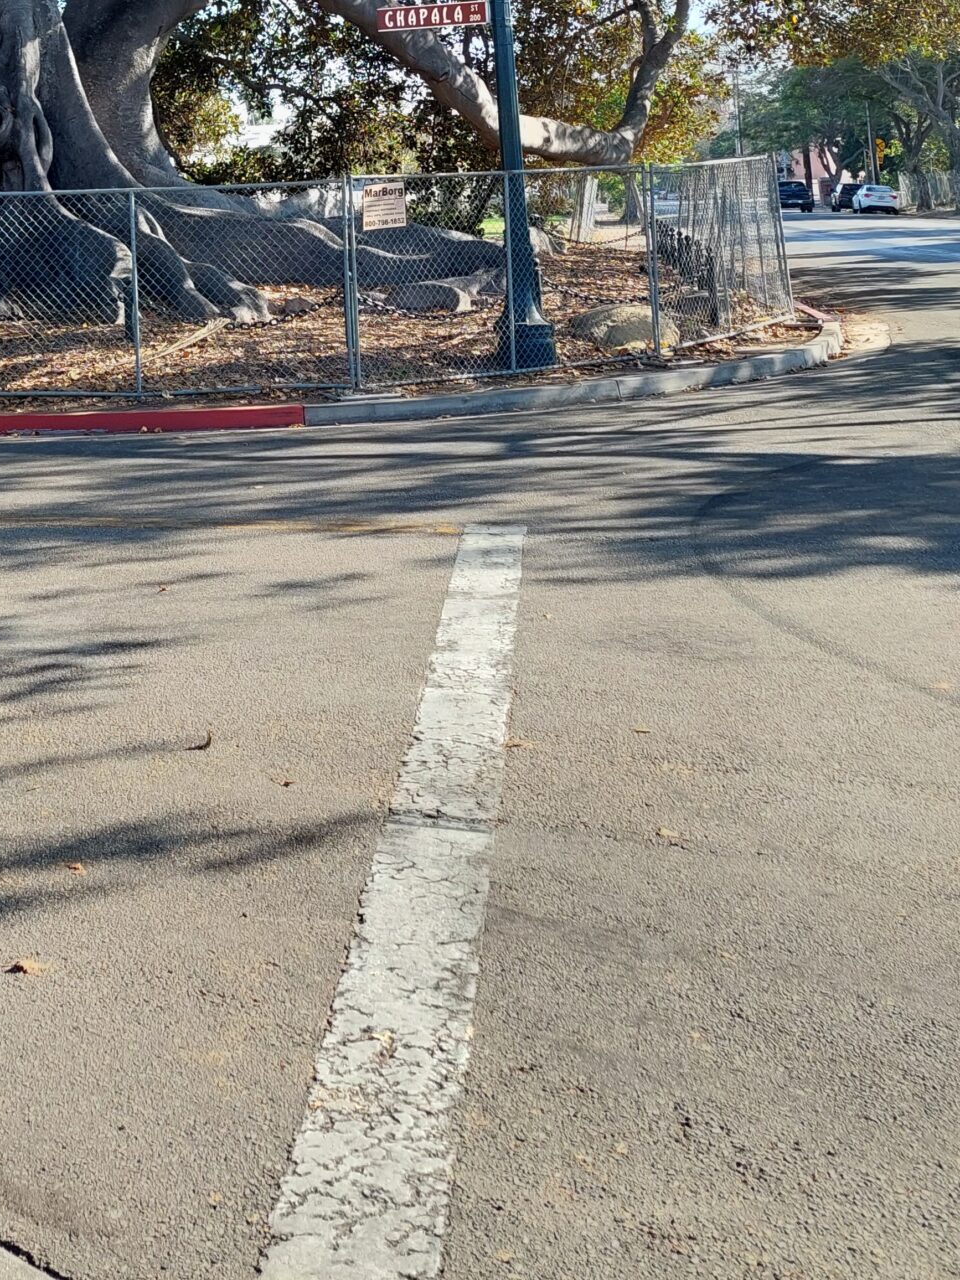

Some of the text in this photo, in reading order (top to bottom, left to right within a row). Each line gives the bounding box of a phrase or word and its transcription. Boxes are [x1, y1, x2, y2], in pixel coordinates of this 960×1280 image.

[384, 4, 479, 28] CHAPALA ST
[469, 14, 481, 22] 200
[364, 187, 404, 198] MarBorg
